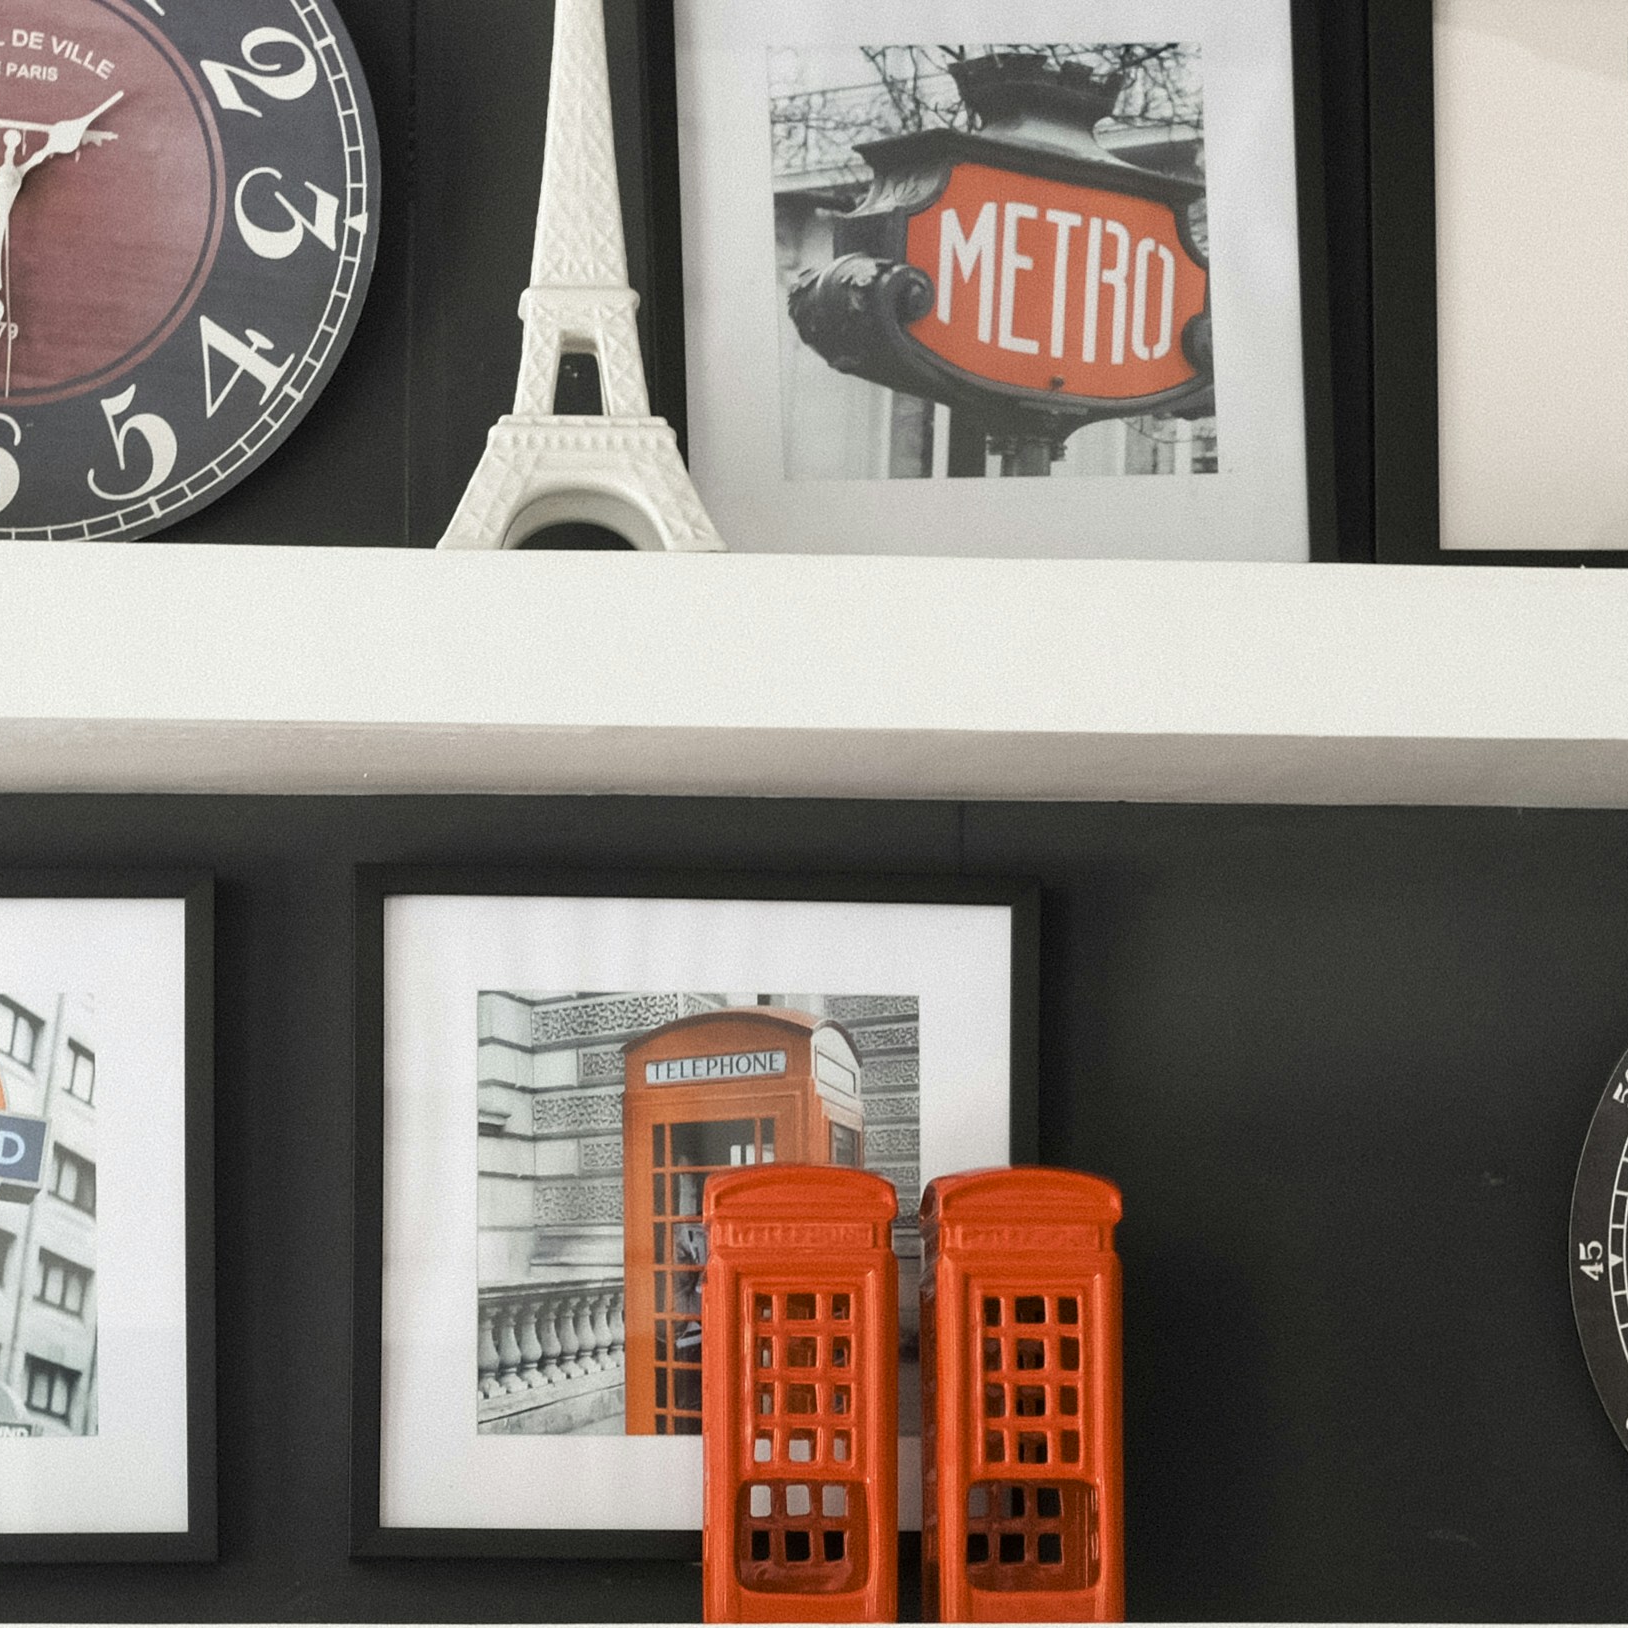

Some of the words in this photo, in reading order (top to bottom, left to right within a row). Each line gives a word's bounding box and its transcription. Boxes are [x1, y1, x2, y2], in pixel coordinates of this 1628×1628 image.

[5, 61, 59, 82] PARIS
[11, 28, 46, 50] DE
[50, 35, 116, 81] VILLE
[200, 27, 316, 118] 2
[234, 166, 340, 260] 3
[936, 201, 1174, 366] METRO
[199, 315, 295, 418] 4
[87, 384, 178, 501] 5
[651, 1053, 781, 1081] TELEPHONE
[1578, 1240, 1604, 1281] 45
